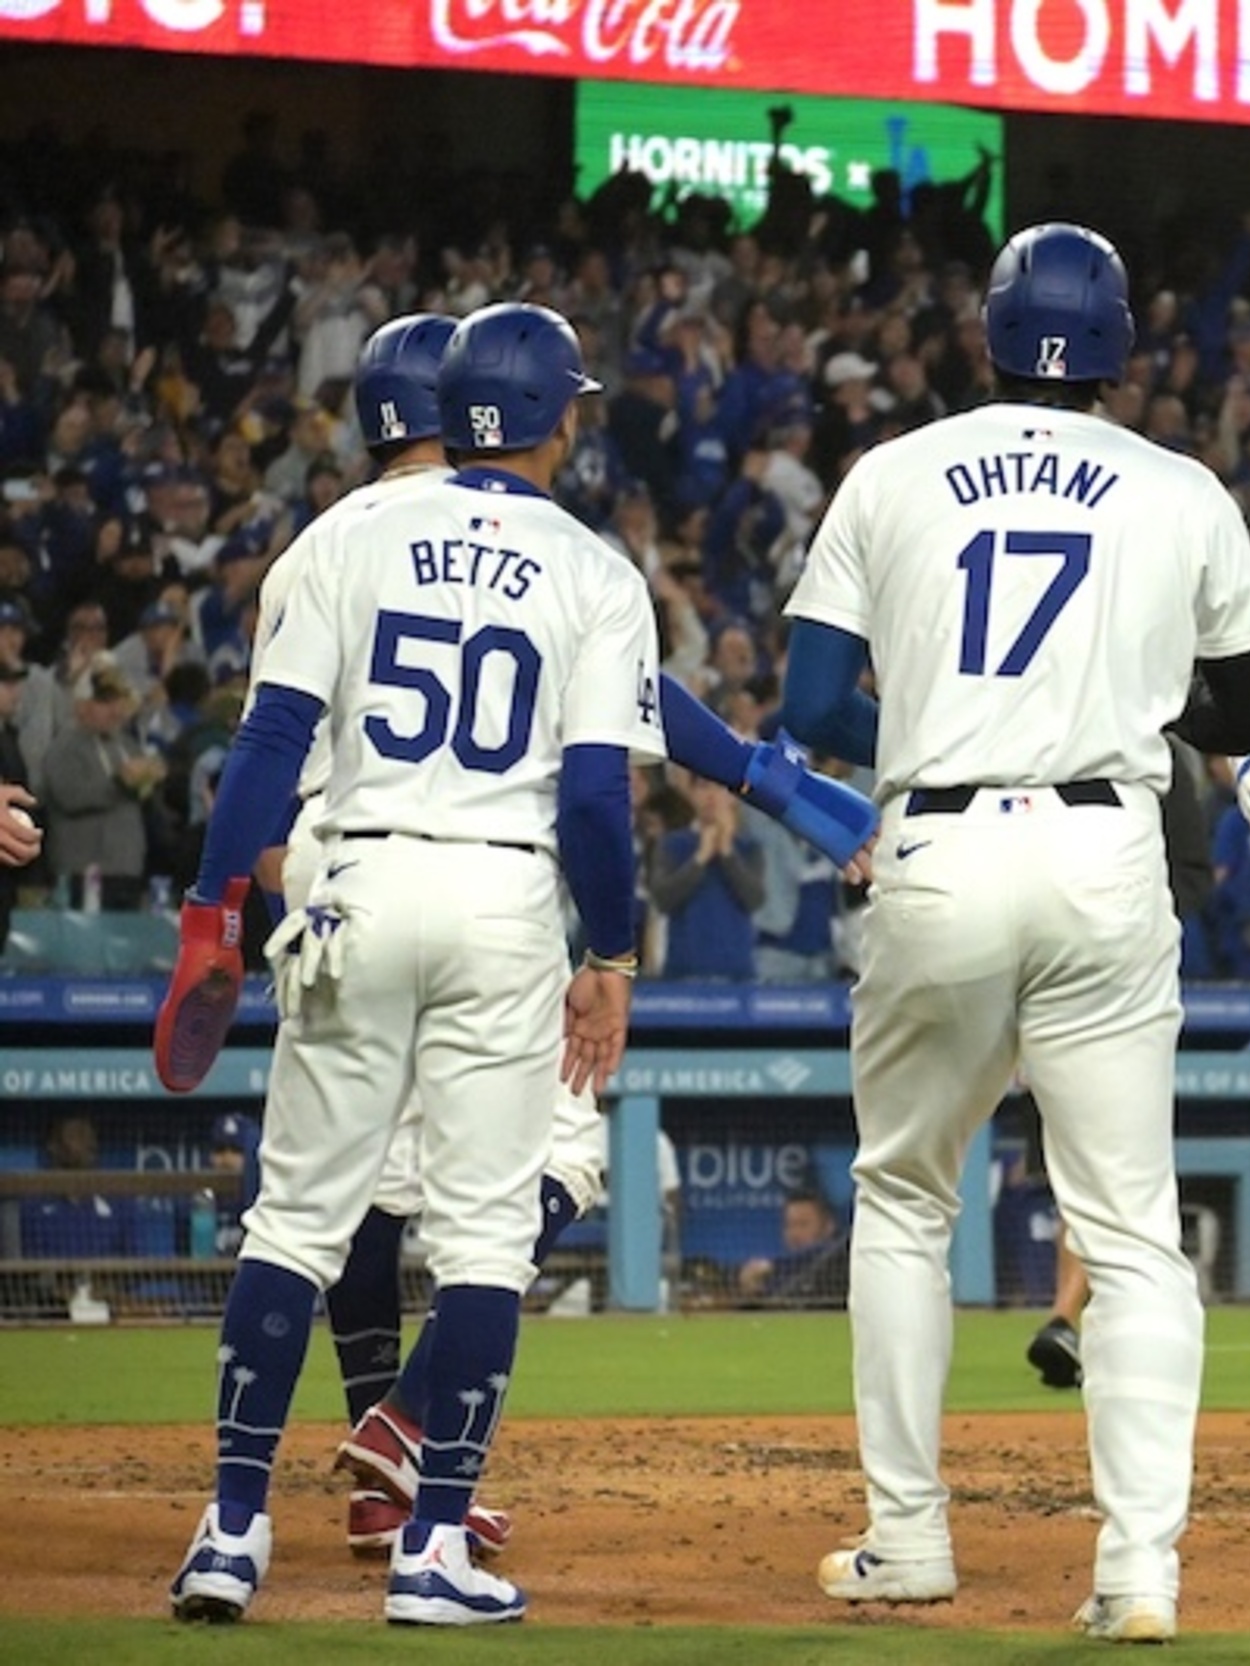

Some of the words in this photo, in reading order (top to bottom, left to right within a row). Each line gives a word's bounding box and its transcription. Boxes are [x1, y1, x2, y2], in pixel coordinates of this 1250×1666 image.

[609, 133, 833, 196] HORNITS
[1039, 337, 1067, 362] 17
[380, 401, 398, 425] 11
[469, 404, 501, 430] 50
[945, 452, 1120, 509] OHTANI
[409, 539, 542, 601] BETTS
[956, 529, 1093, 677] 17
[362, 608, 543, 775] 50
[3, 1069, 33, 1093] OF
[39, 1069, 149, 1093] AMERICA
[624, 1070, 655, 1090] OF
[659, 1070, 764, 1091] AMERICA
